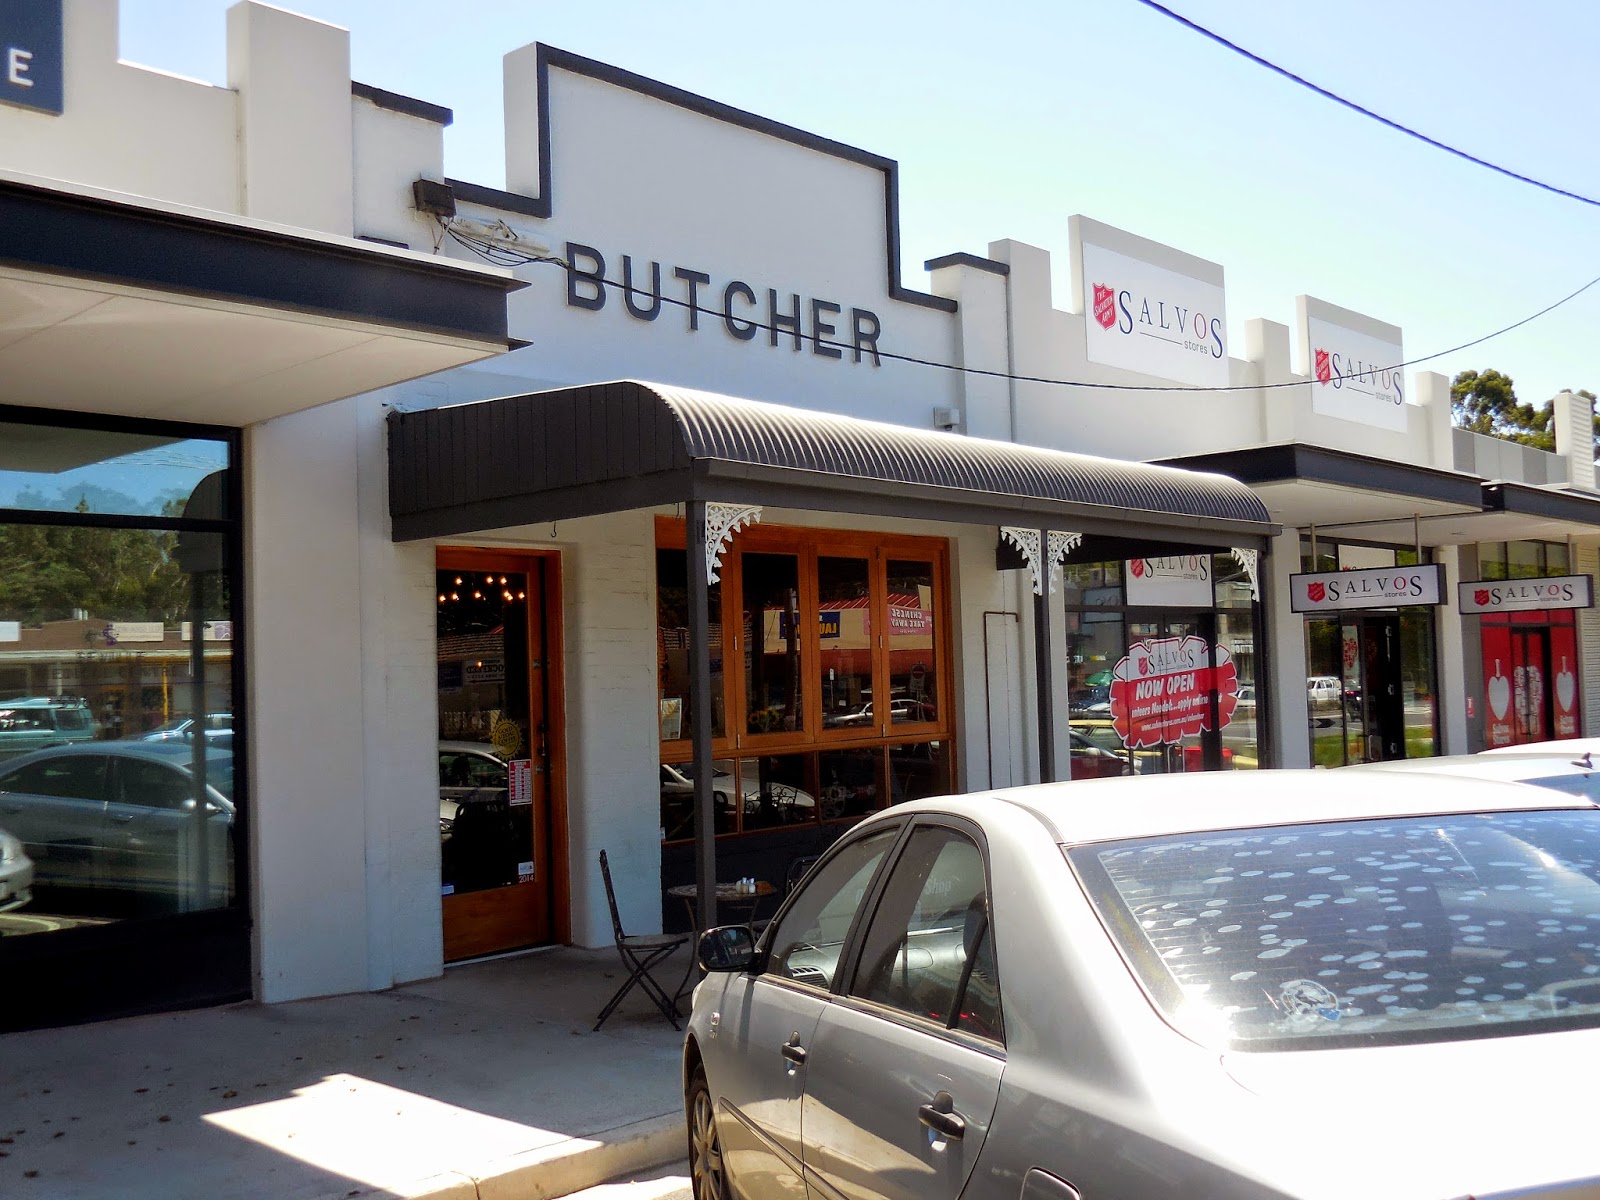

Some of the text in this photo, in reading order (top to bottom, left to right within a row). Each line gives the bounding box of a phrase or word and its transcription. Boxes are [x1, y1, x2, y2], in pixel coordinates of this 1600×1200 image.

[566, 241, 882, 367] BUTCHER
[1118, 290, 1223, 359] SALVOS
[1184, 340, 1208, 355] stores
[1332, 353, 1402, 405] SALVOS
[1145, 554, 1208, 581] SALVOS
[1328, 575, 1423, 602] SALVOS
[1491, 584, 1574, 605] SALVOS
[1148, 649, 1194, 675] SALVOS
[1135, 673, 1195, 701] NOW OPEN
[519, 874, 534, 884] 2014
